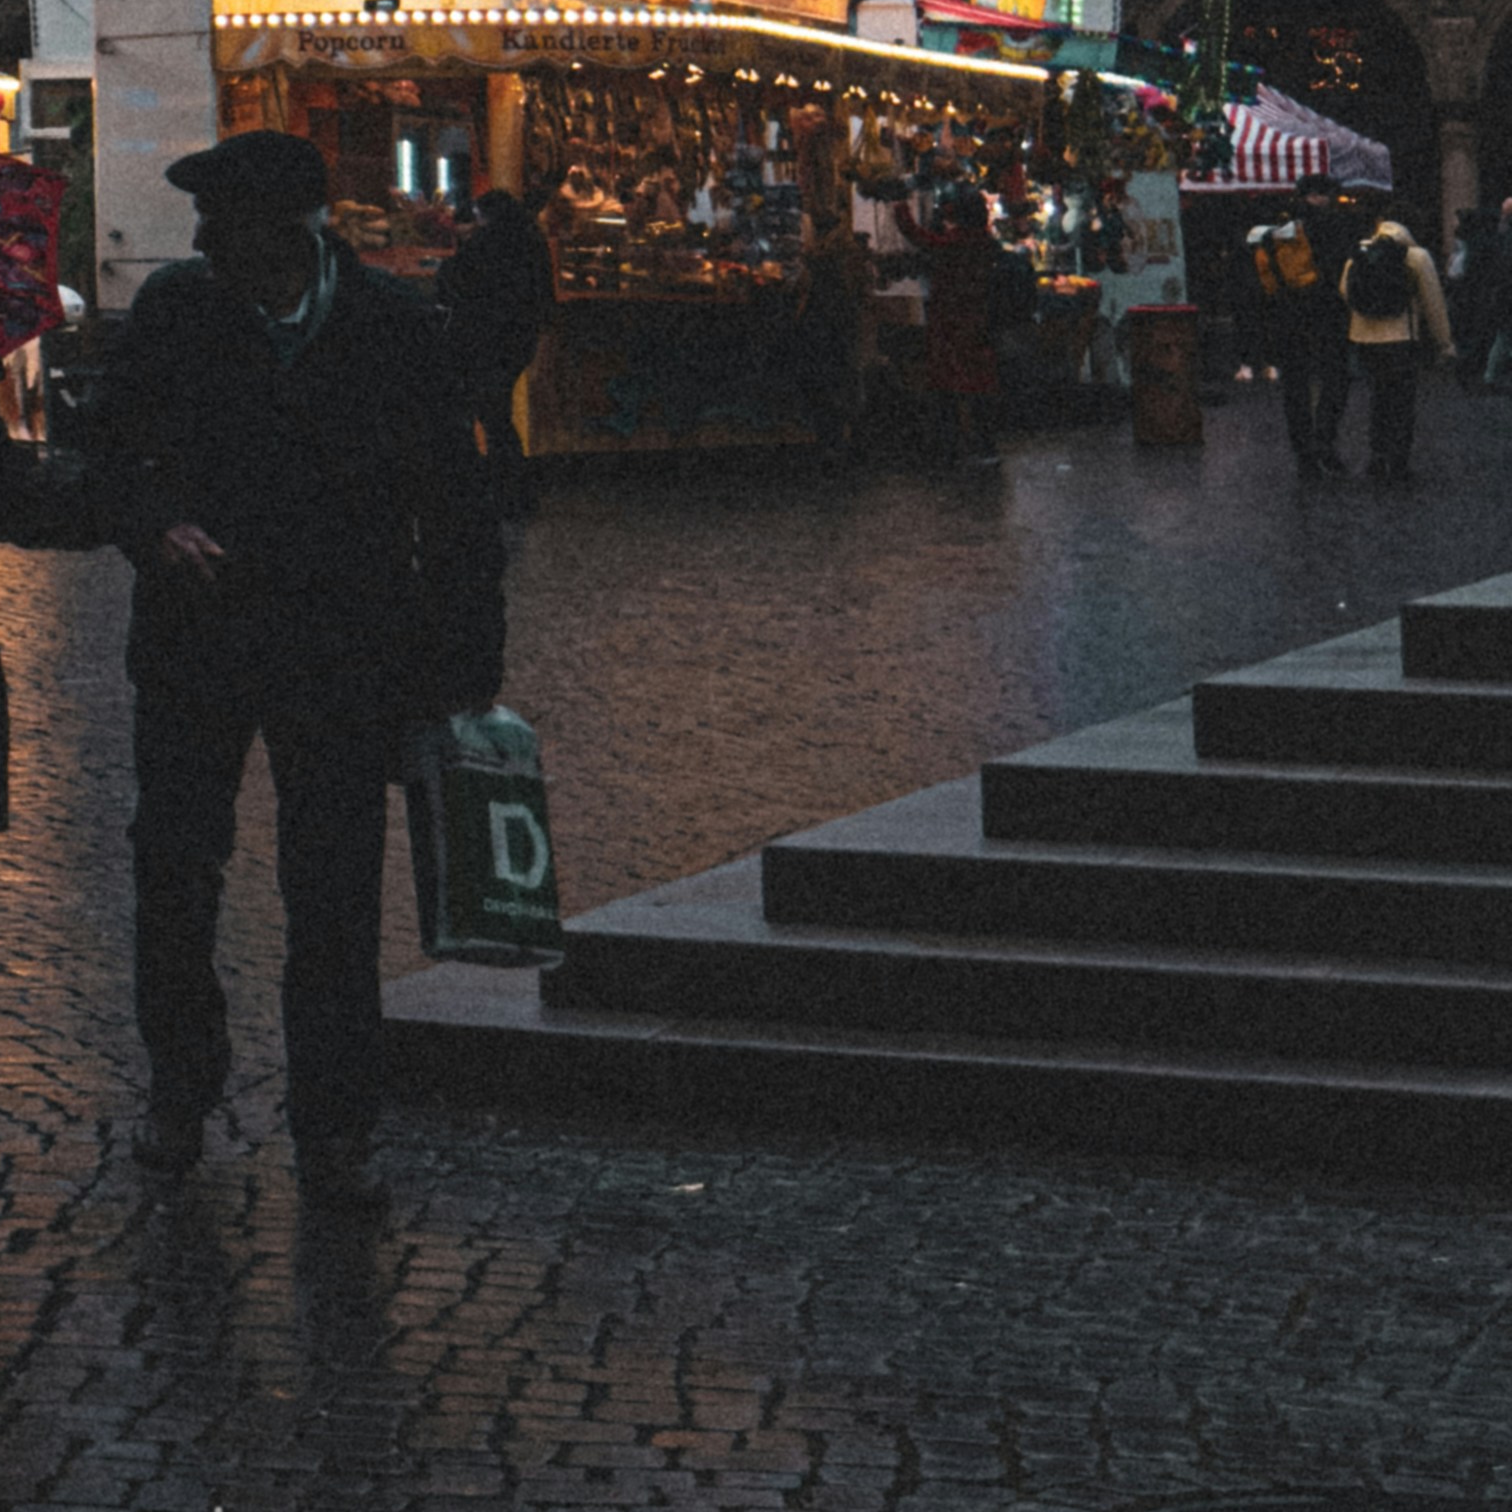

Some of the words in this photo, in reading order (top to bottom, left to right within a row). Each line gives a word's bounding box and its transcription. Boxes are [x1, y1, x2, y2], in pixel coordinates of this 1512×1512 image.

[298, 30, 407, 58] Popcorn
[501, 29, 641, 54] Kandierte
[487, 800, 550, 889] D
